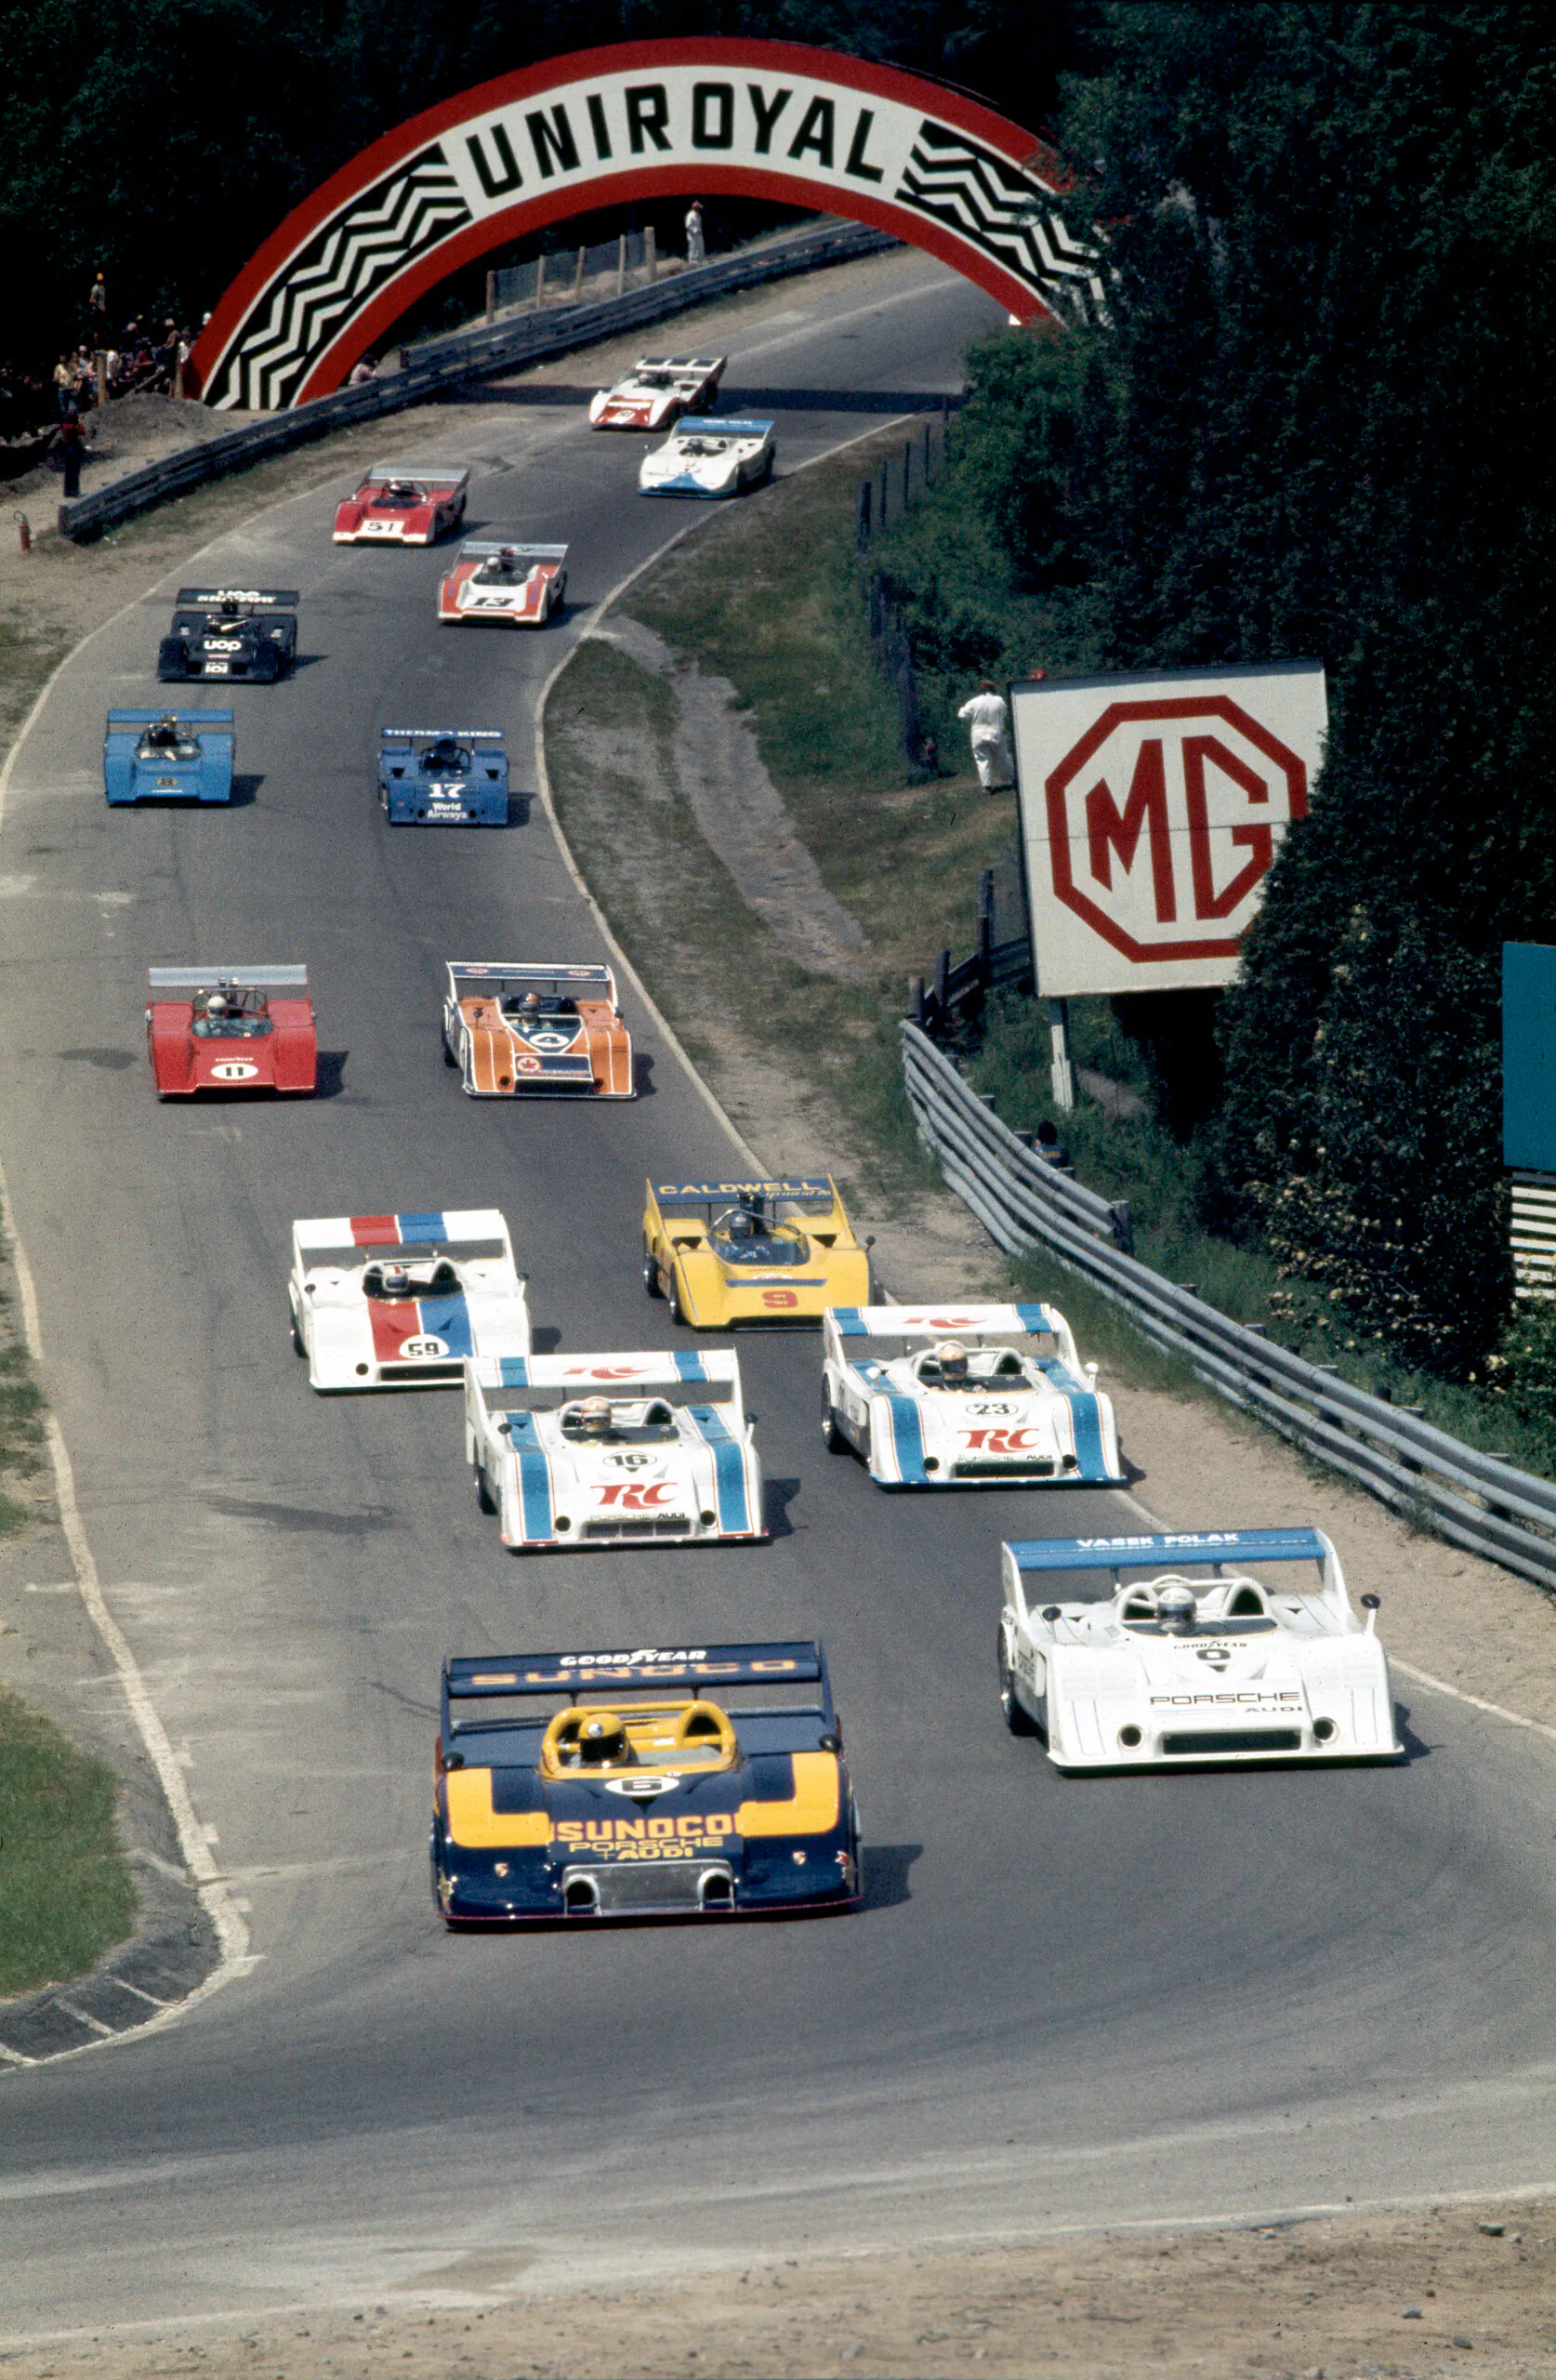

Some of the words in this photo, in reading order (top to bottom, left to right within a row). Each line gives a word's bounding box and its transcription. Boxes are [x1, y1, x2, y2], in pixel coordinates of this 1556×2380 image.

[465, 82, 884, 198] UNIROYAL
[367, 522, 395, 532] 51
[429, 783, 467, 799] 17
[432, 802, 462, 812] World
[428, 810, 468, 821] Airways
[1085, 734, 1273, 923] MG
[225, 1066, 244, 1077] 11
[659, 1182, 823, 1196] CALDWELL
[762, 1290, 798, 1308] 9
[408, 1342, 441, 1356] 59
[973, 1403, 1011, 1415] 23
[956, 1428, 1040, 1454] RC
[610, 1454, 649, 1466] 16
[589, 1482, 678, 1510] RC
[656, 1512, 686, 1520] AUDI
[1076, 1537, 1154, 1549] VASEK
[1164, 1533, 1241, 1545] POLAK
[471, 1659, 797, 1685] SUNOCO
[1149, 1692, 1301, 1706] PORSCHE
[621, 1778, 663, 1792] 6
[558, 1814, 733, 1842] SUNOCO
[569, 1835, 724, 1853] PORSCHE
